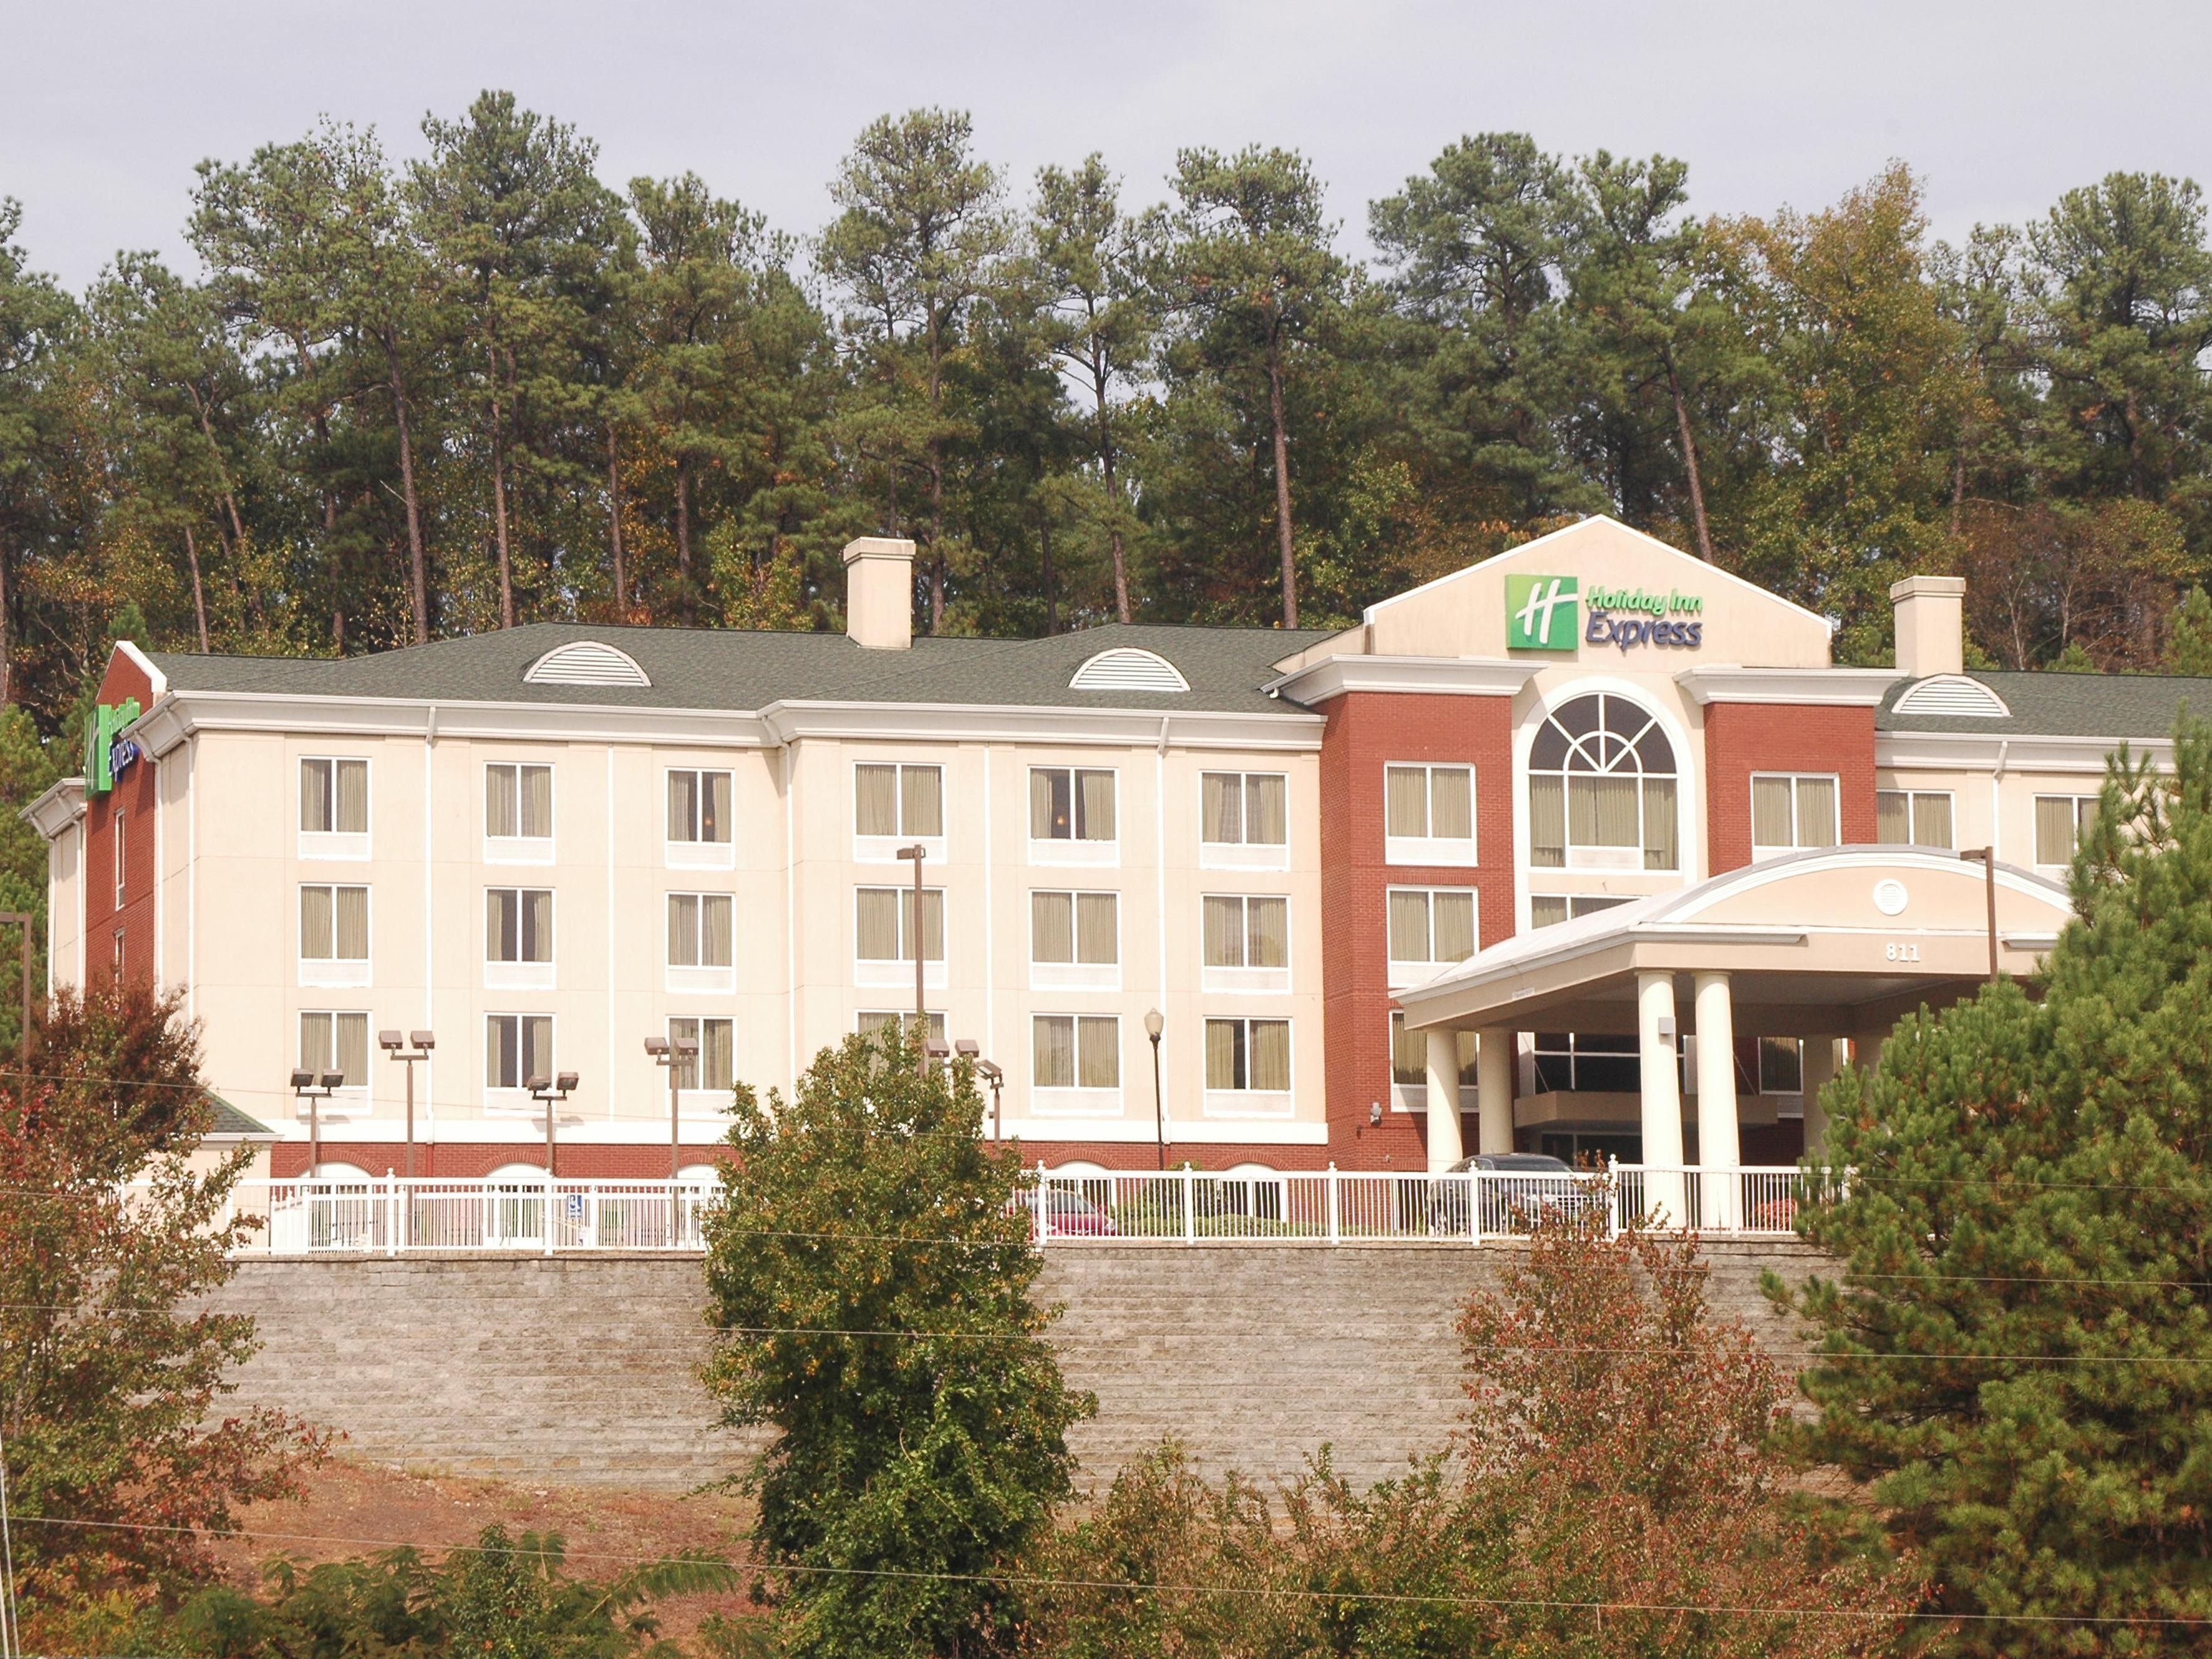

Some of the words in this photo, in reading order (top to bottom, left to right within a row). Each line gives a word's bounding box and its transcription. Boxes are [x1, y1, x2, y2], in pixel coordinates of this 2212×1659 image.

[1586, 585, 1668, 616] Holiday
[1669, 588, 1703, 612] Inn
[1585, 611, 1703, 651] Express
[1885, 942, 1921, 962] 811
